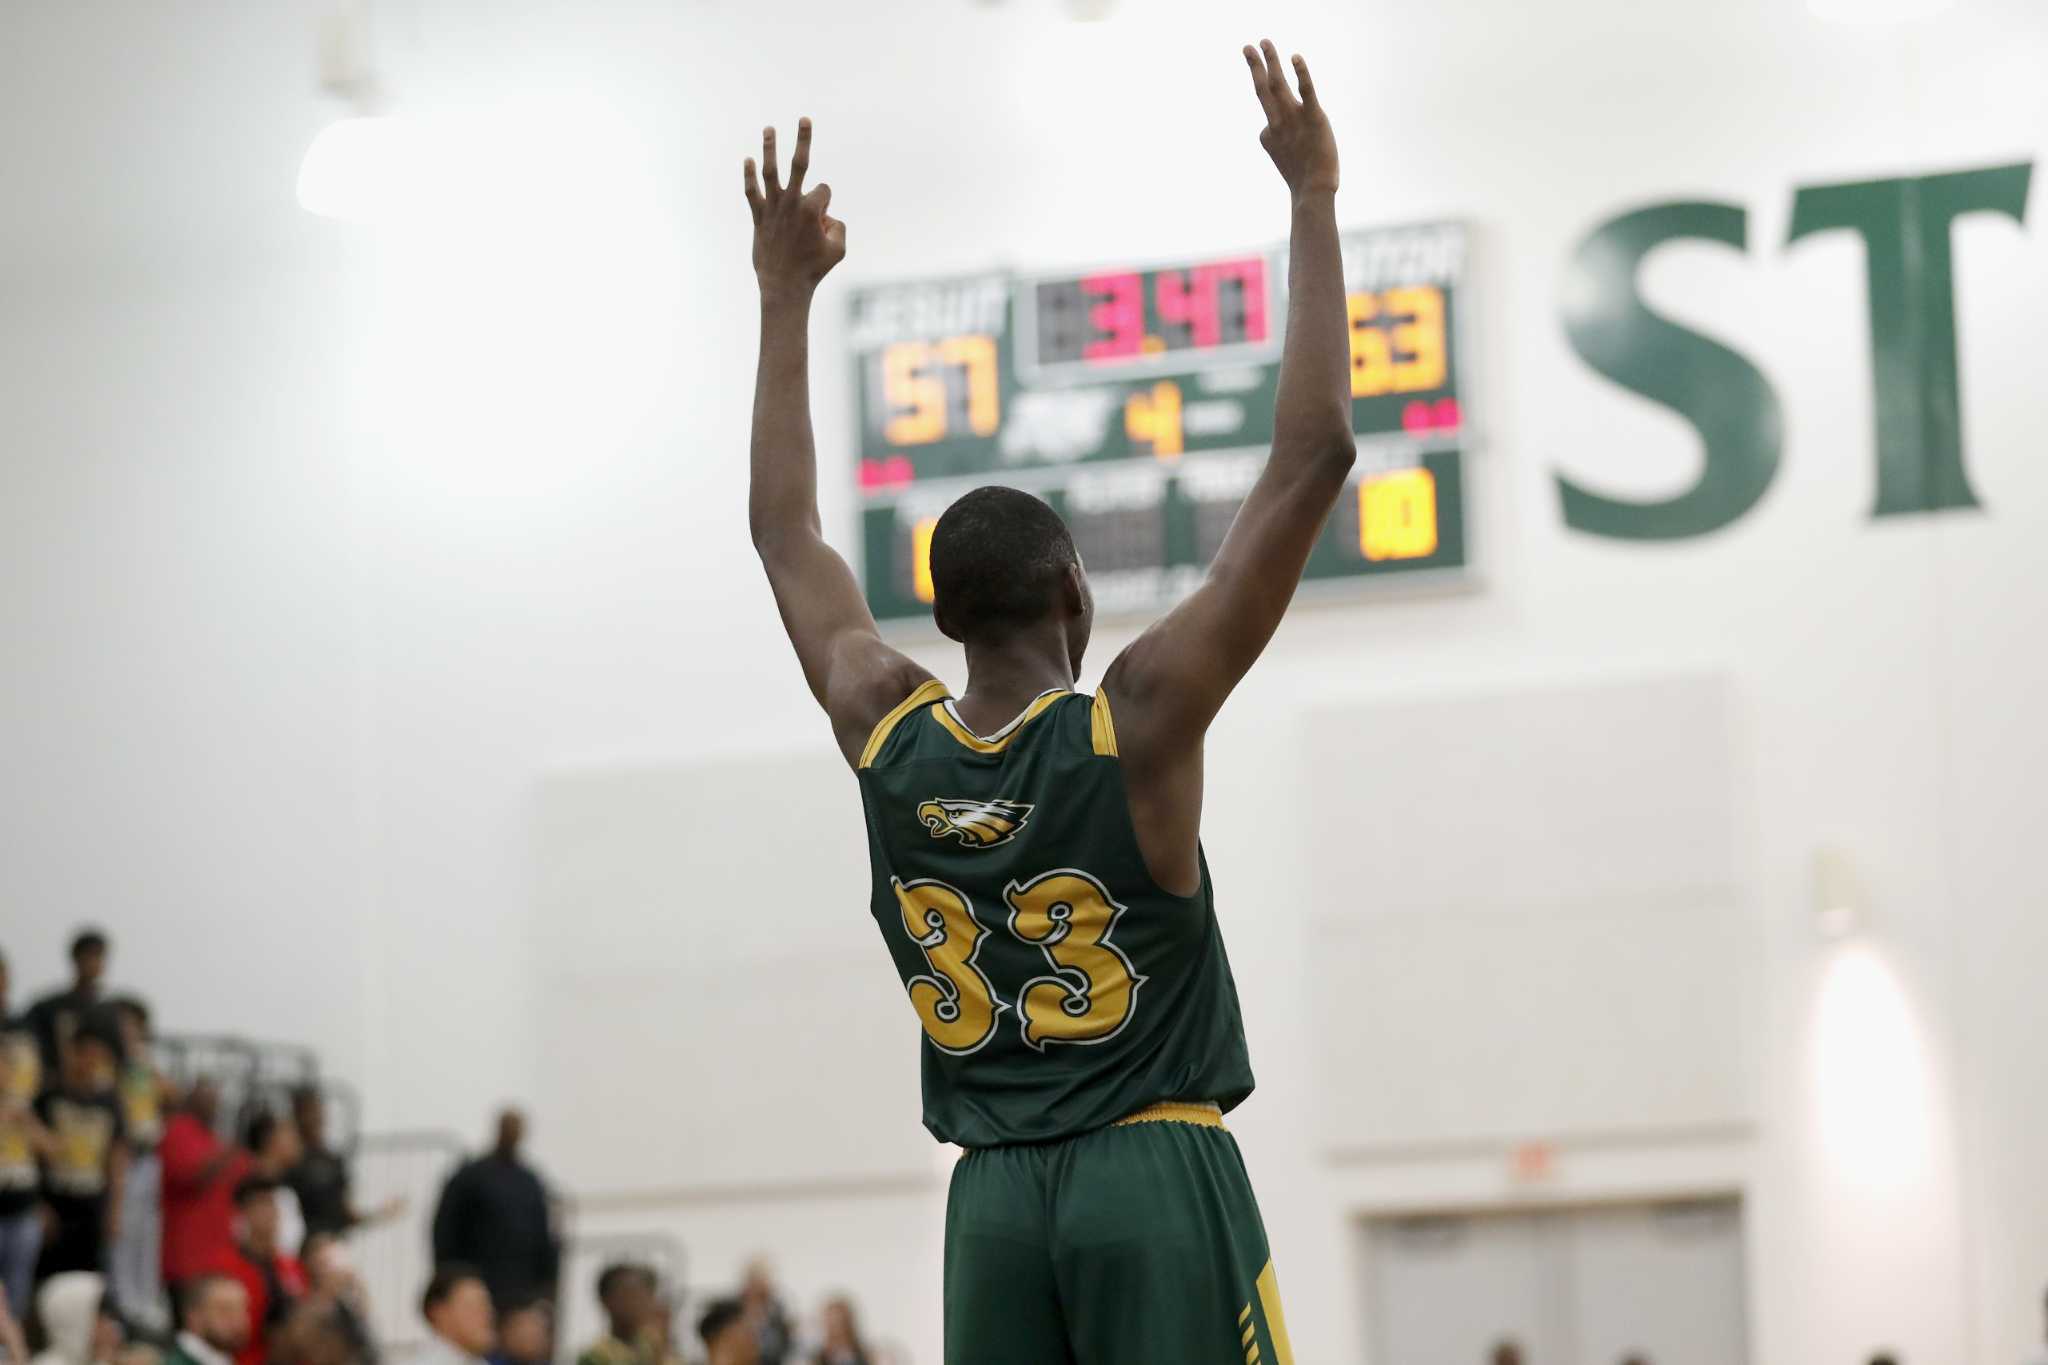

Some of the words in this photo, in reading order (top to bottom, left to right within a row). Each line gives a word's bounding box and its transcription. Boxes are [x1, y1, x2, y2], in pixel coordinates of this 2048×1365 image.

[883, 334, 998, 445] 57
[1346, 283, 1448, 398] 63
[1124, 380, 1184, 463] 4
[889, 867, 1149, 1055] 33
